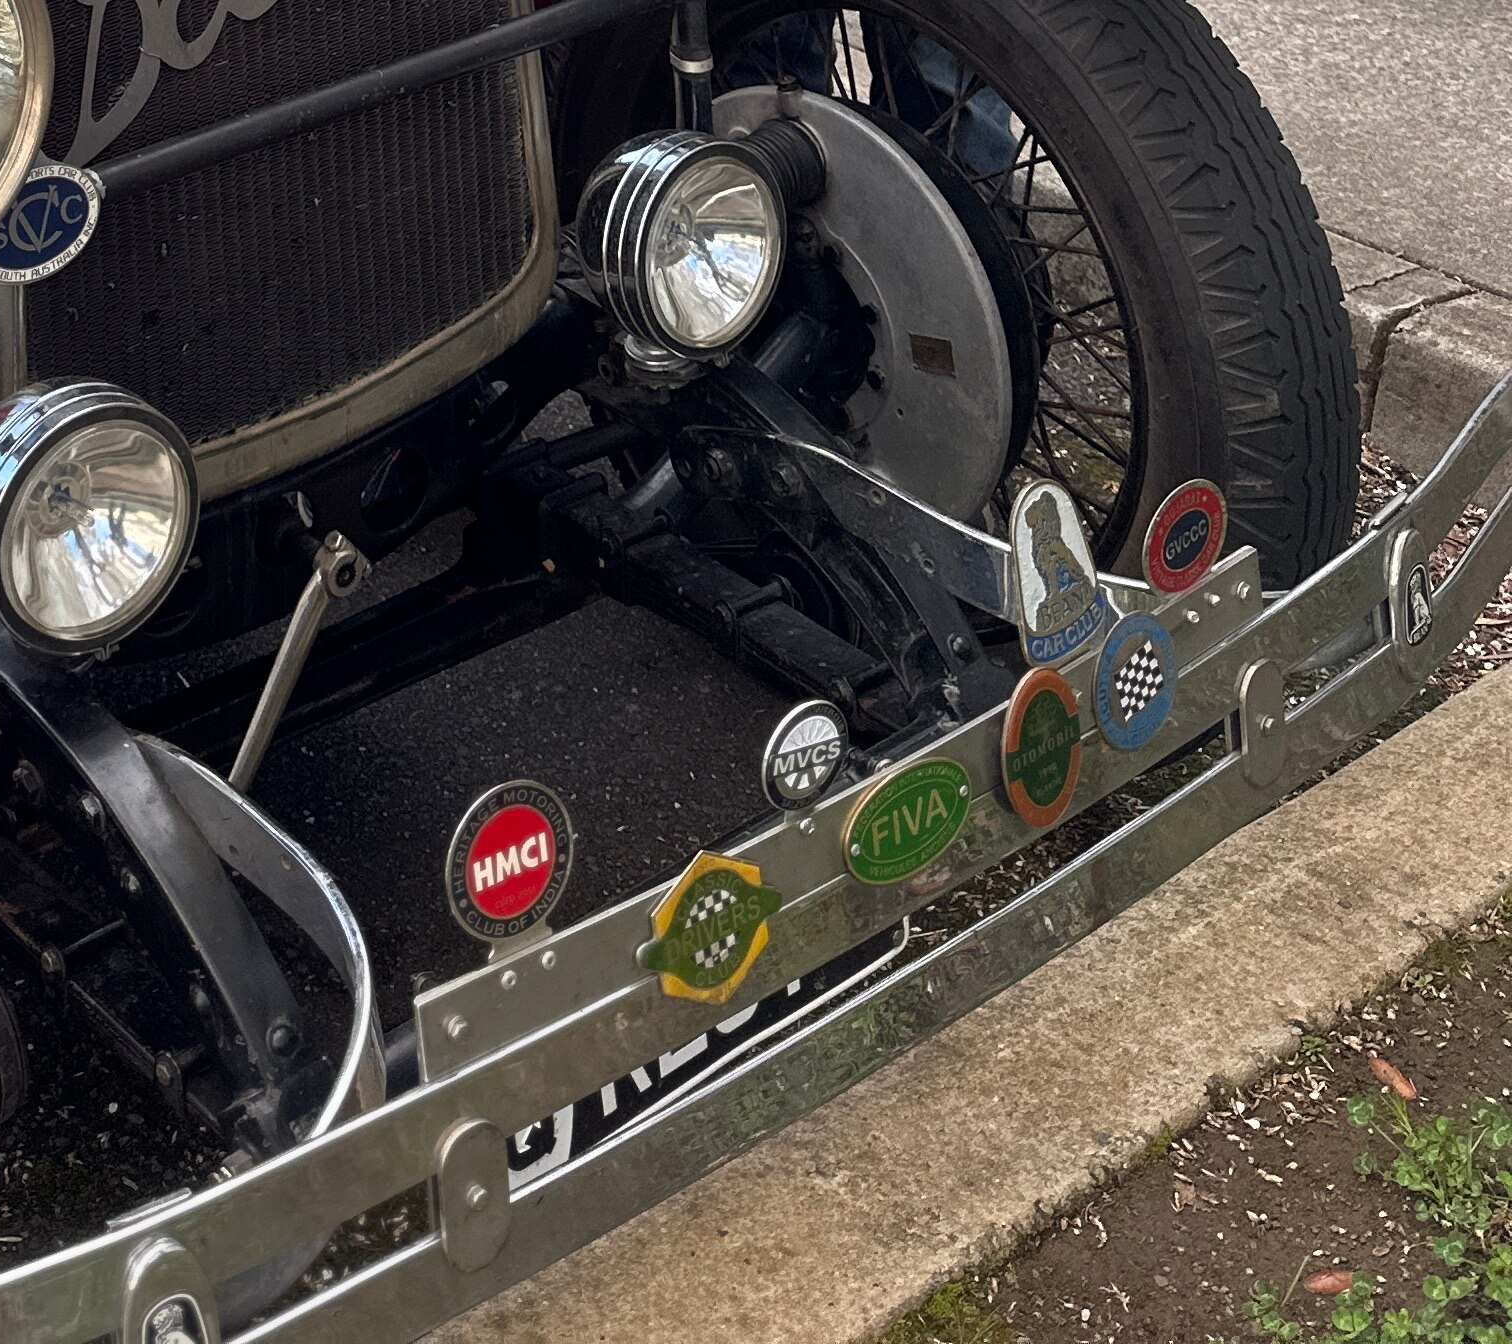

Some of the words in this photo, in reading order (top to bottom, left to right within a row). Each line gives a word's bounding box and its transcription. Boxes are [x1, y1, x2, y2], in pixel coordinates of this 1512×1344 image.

[58, 167, 78, 180] CAR
[78, 173, 98, 202] CLUB
[31, 239, 84, 280] AUSTRALIA
[1165, 519, 1207, 560] GVCCC
[1031, 634, 1067, 659] CAR
[1065, 602, 1103, 645] CLUB
[773, 740, 841, 777] MVCS
[453, 797, 500, 895] HERITAGE
[503, 789, 567, 847] MOTORING
[871, 788, 948, 857] FIVA
[473, 832, 549, 892] HMCI
[466, 911, 505, 936] CLUB
[508, 916, 529, 933] OF
[531, 870, 565, 920] INDIA
[677, 872, 742, 921] CLASSIC
[664, 895, 761, 964] DRIVERS
[695, 955, 741, 987] CLUB
